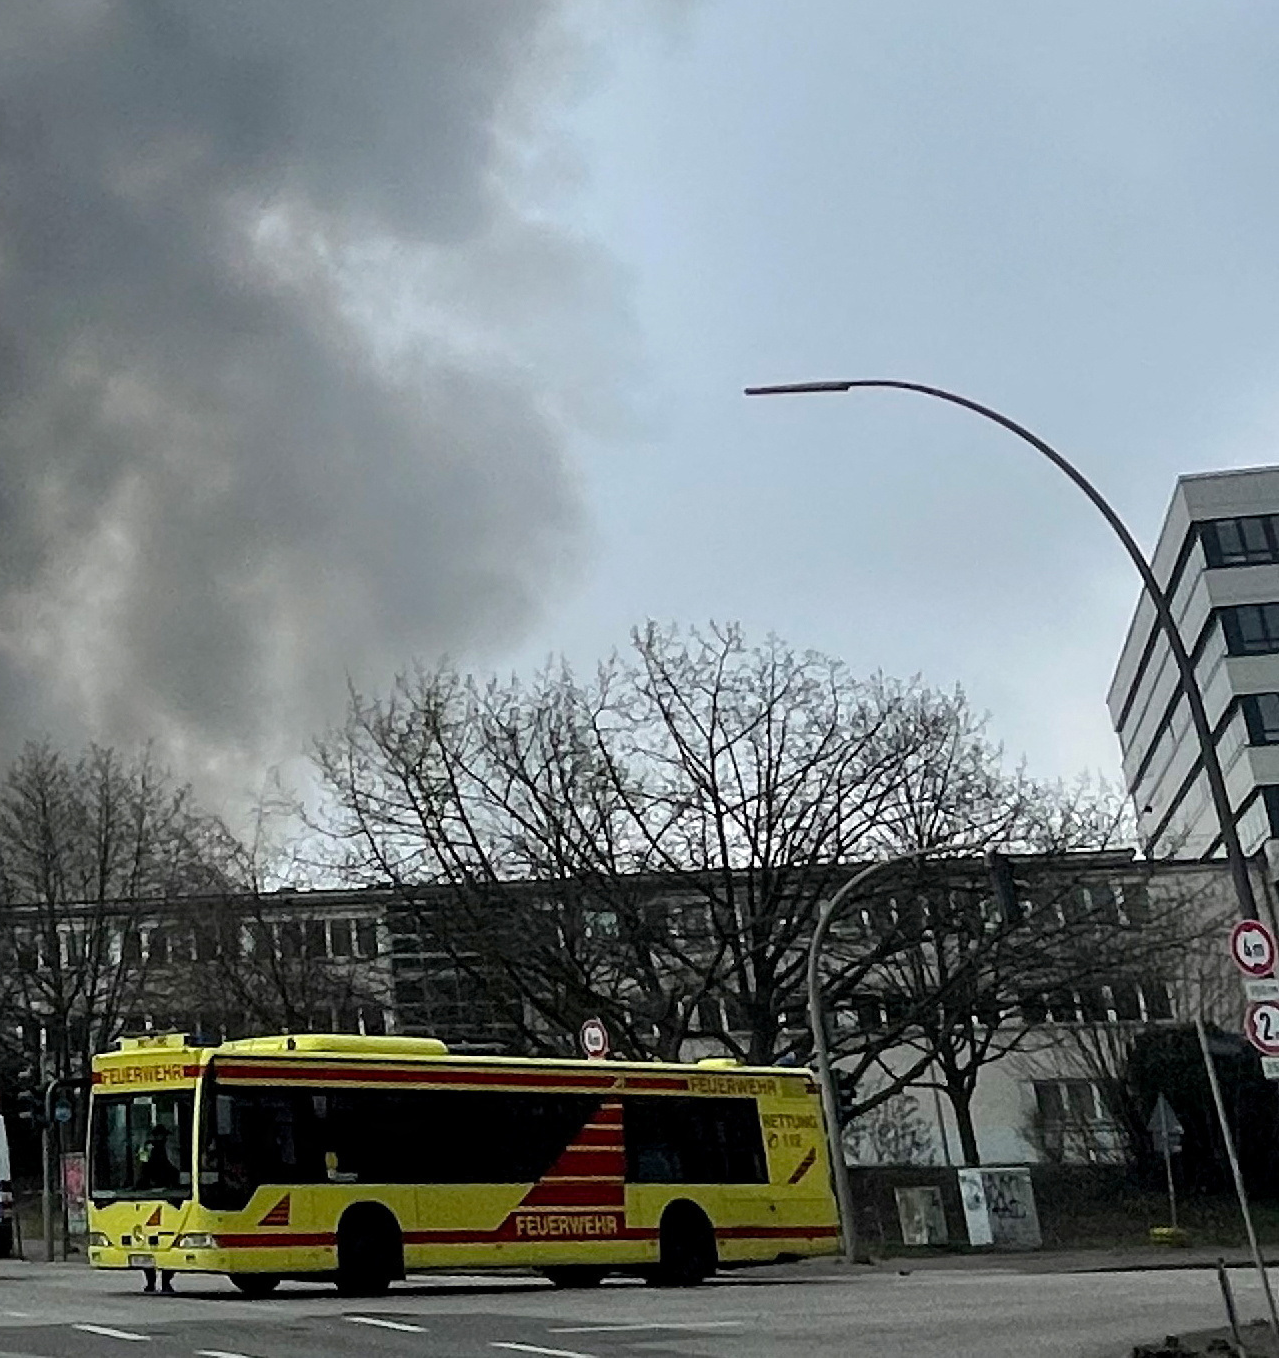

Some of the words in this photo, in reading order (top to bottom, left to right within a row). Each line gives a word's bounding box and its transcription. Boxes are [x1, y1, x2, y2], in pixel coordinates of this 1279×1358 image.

[1258, 1012, 1279, 1041] 2
[102, 1064, 183, 1085] FEUERWEHR
[690, 1077, 778, 1096] FEUERWEHR
[762, 1113, 818, 1129] RETTUNG
[516, 1215, 618, 1237] FEUERWEHR
